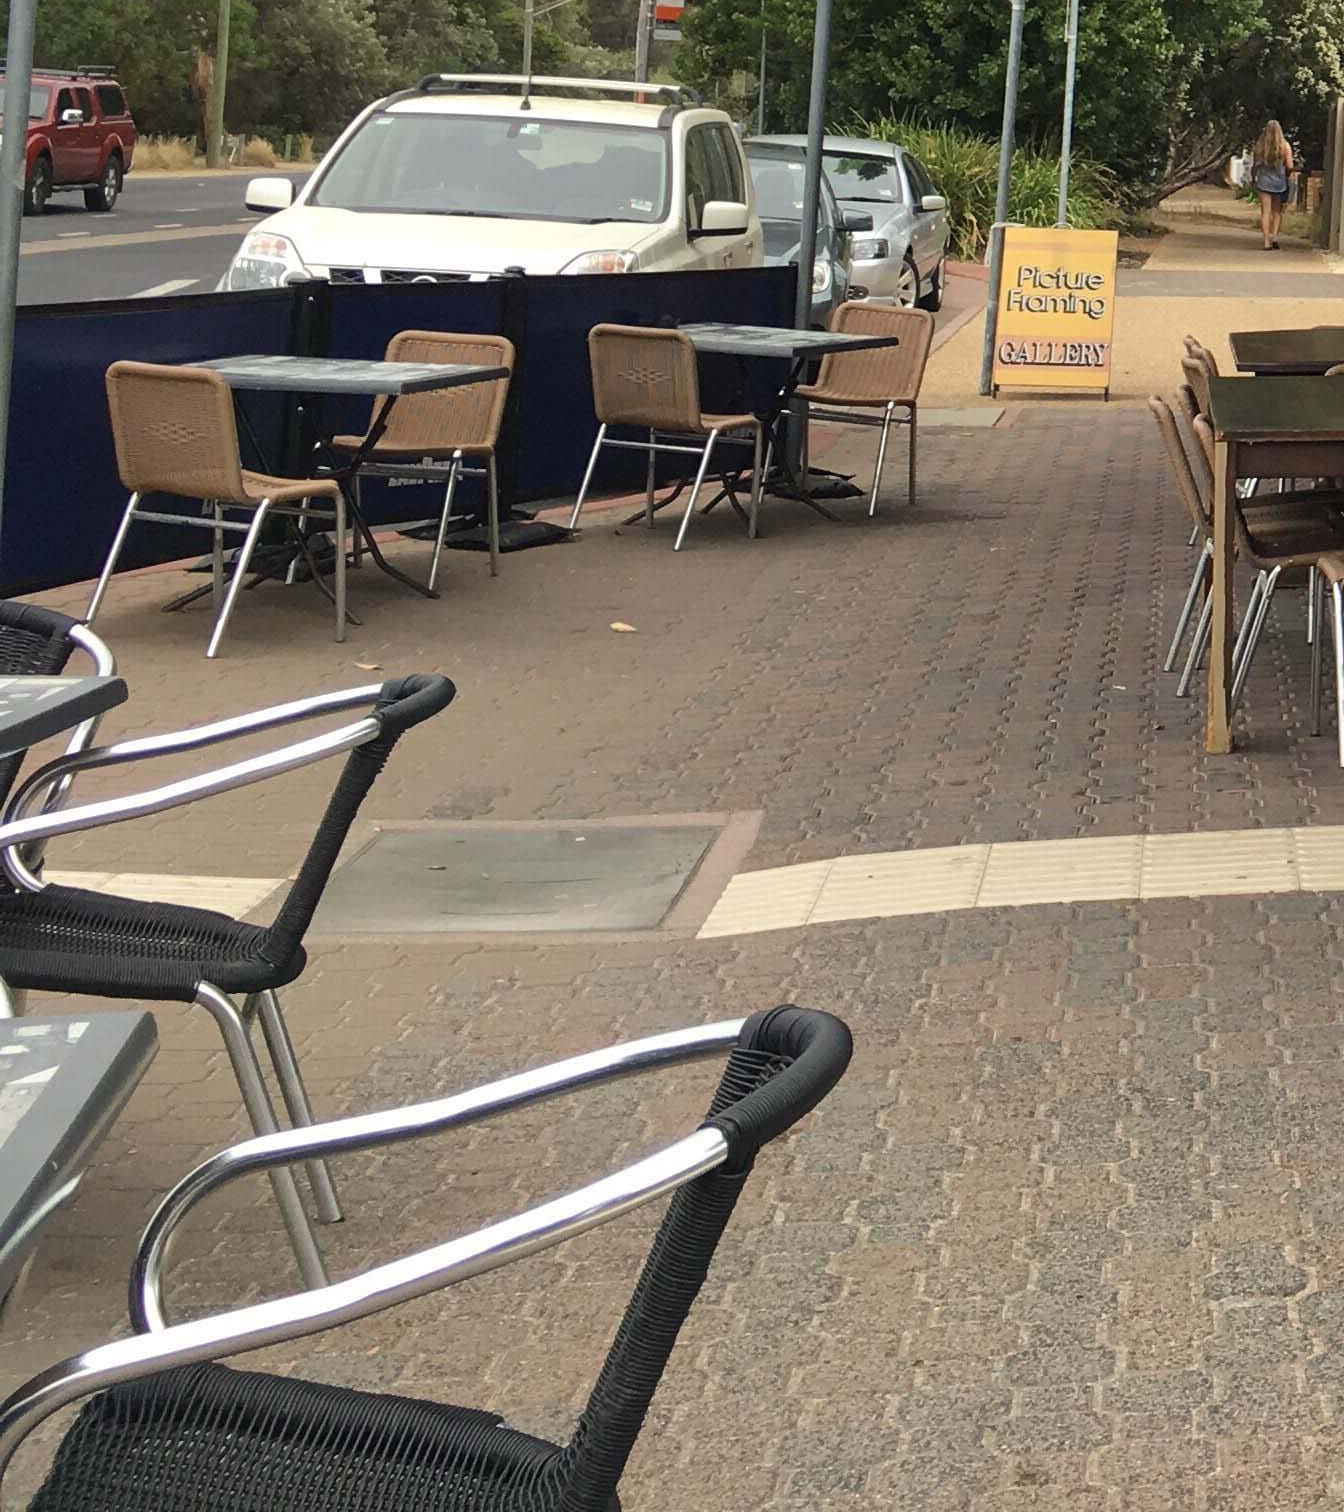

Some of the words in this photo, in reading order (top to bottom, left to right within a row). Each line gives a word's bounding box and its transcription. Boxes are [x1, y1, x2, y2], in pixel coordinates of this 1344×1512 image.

[1017, 264, 1105, 290] Picture
[1006, 289, 1108, 319] Framing
[998, 340, 1109, 368] GALLERY
